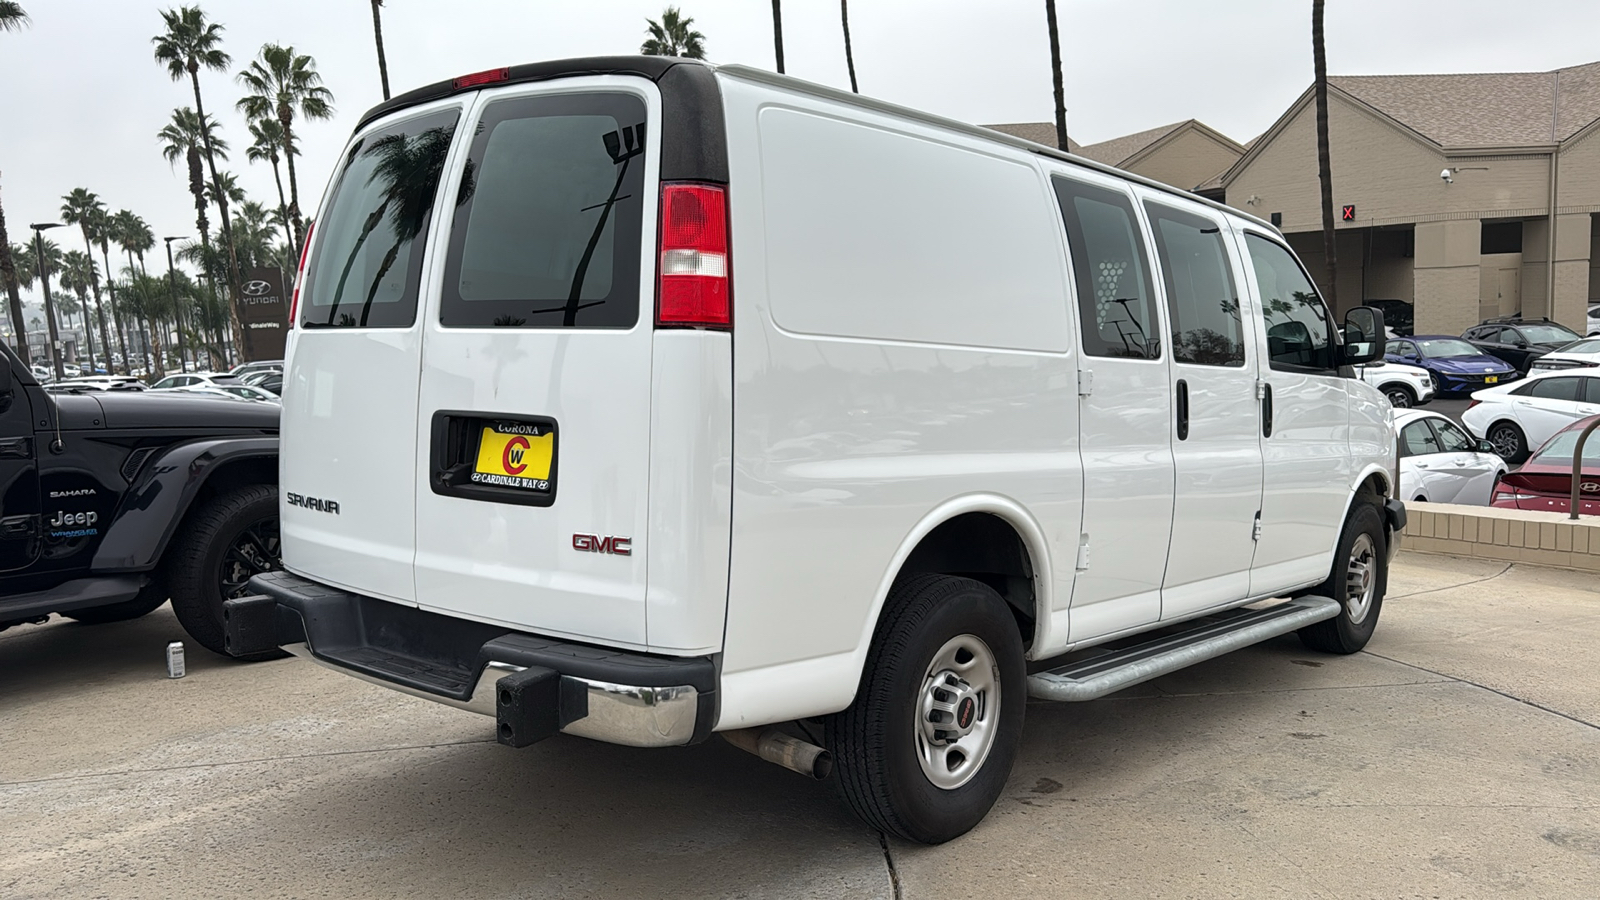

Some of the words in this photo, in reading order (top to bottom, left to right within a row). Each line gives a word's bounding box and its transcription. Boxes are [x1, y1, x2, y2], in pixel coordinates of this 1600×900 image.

[498, 424, 539, 434] CORONA
[481, 474, 521, 487] CARDINALE
[522, 477, 538, 489] WAY
[50, 489, 97, 498] SAHARA
[287, 491, 340, 515] SAVANA
[50, 510, 98, 527] Jeep
[572, 532, 632, 556] GMC
